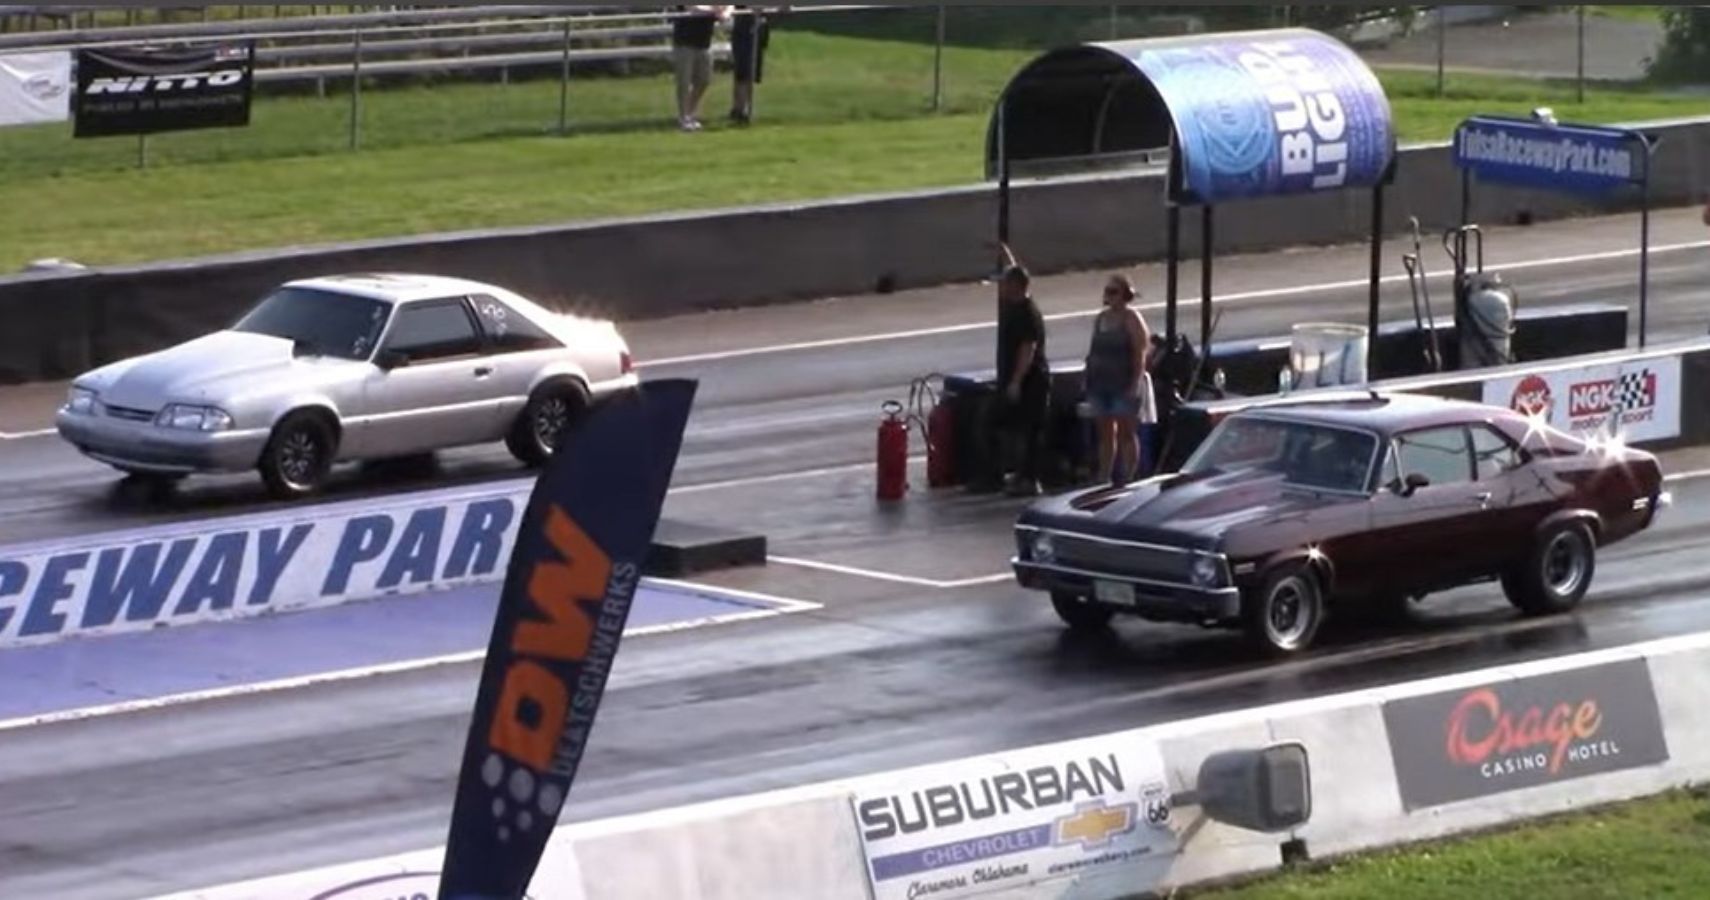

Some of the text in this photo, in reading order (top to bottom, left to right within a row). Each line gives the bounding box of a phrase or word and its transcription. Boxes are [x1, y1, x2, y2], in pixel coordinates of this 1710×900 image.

[86, 69, 243, 95] NITTO
[1238, 51, 1314, 175] BUD
[1251, 42, 1348, 189] LIGHT
[1571, 384, 1614, 413] NGK
[489, 503, 613, 773] DW
[1445, 687, 1602, 775] Osage
[1480, 740, 1620, 778] CASINO HOTEL
[860, 753, 1124, 841] SUBURBAN
[1148, 801, 1169, 824] 66
[921, 829, 1040, 866] CHEVROLET
